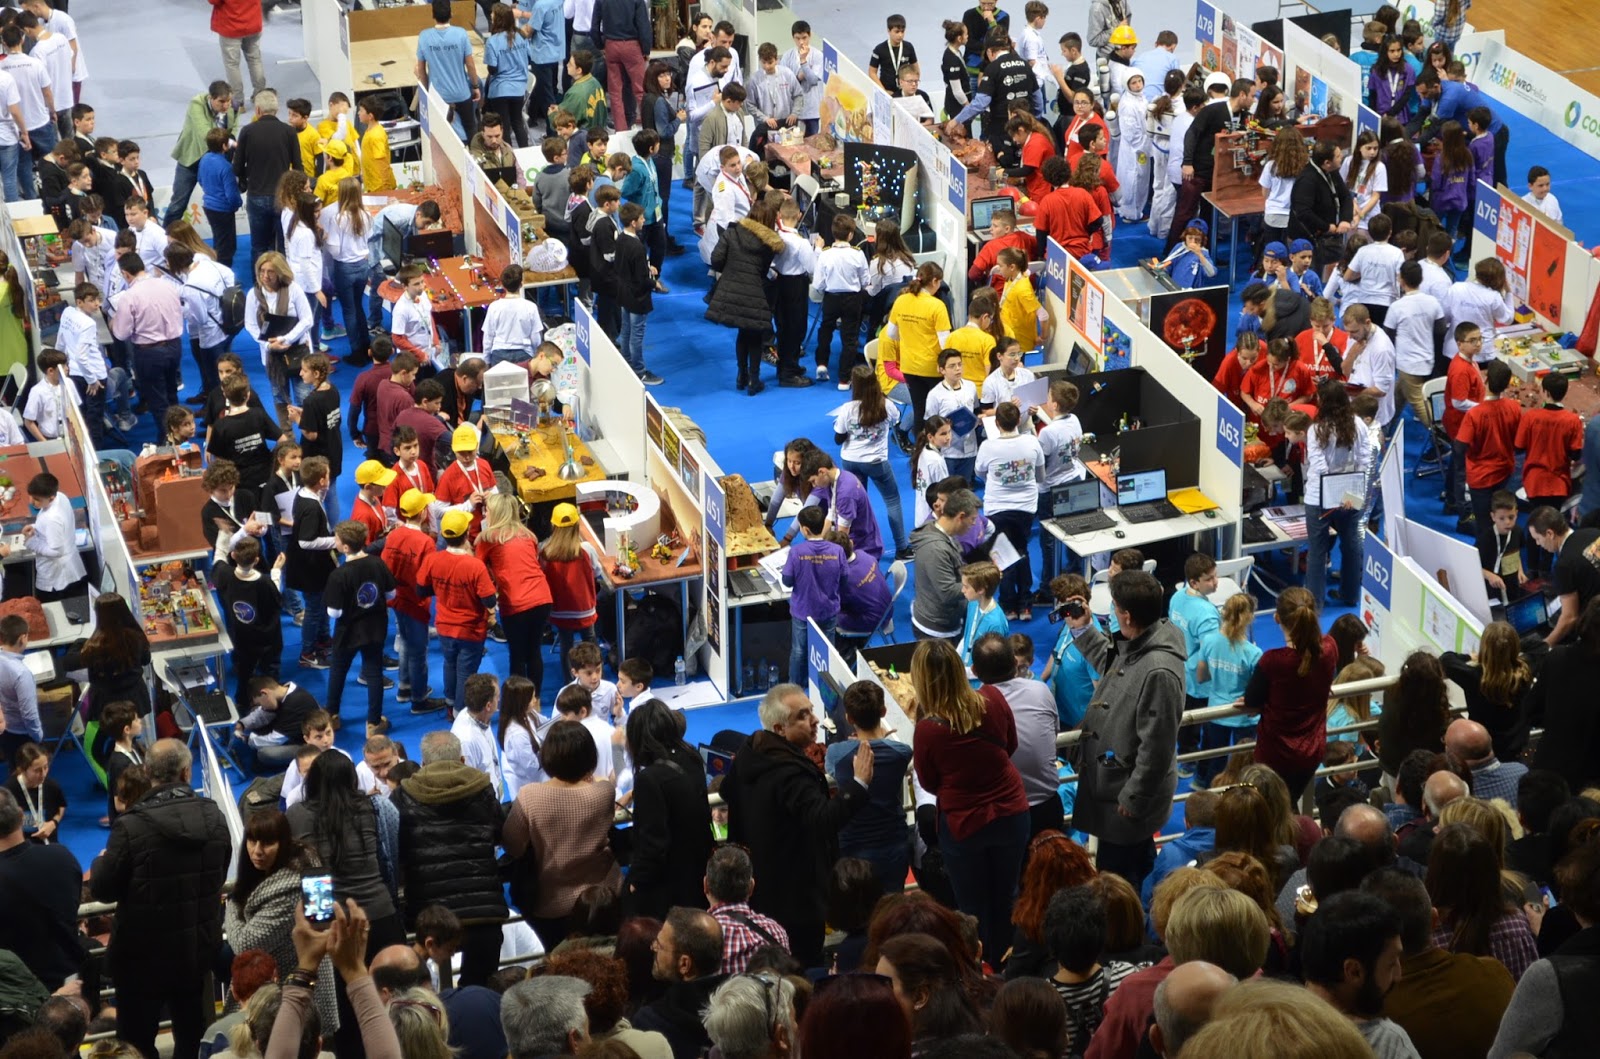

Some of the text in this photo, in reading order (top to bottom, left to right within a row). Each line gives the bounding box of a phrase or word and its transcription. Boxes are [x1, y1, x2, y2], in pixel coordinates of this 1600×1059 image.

[1197, 14, 1213, 36] Δ78
[1000, 60, 1025, 69] COACH
[949, 174, 964, 198] Δ65
[1476, 200, 1498, 226] Δ76
[1047, 258, 1065, 285] Δ64
[1219, 417, 1240, 448] Δ63
[706, 495, 722, 528] Δ51
[1365, 555, 1389, 590] Δ62
